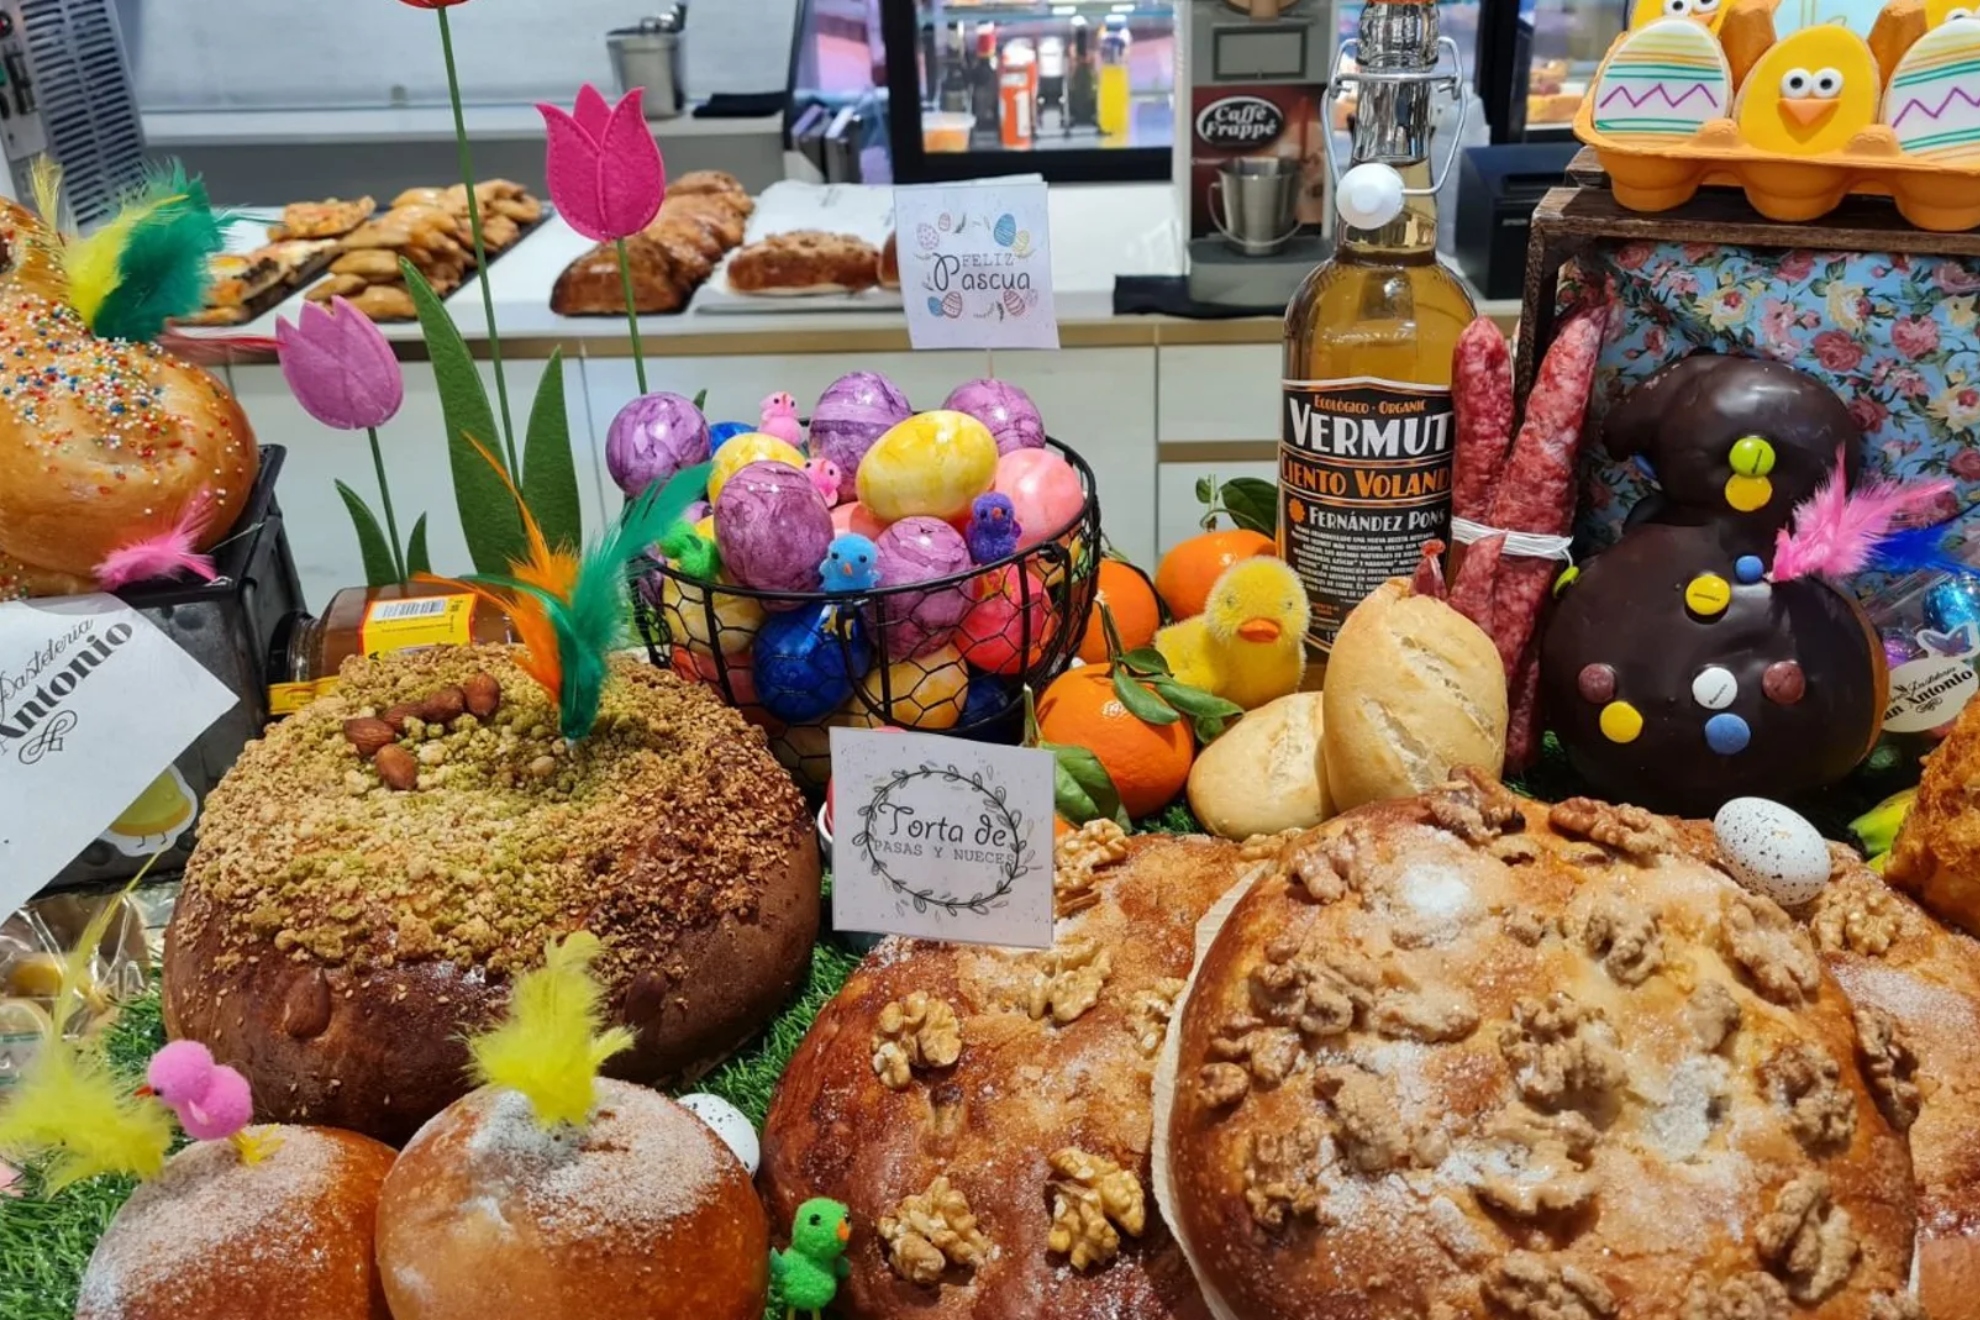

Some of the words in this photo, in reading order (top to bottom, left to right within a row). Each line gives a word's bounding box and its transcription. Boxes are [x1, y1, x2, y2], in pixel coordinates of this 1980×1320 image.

[932, 252, 1031, 292] Pascua
[961, 253, 1015, 268] FELIZ
[1378, 399, 1427, 415] ORGANIC
[1289, 397, 1454, 458] VERMUT
[1309, 505, 1404, 532] FERNÁNDEZ
[1408, 508, 1446, 531] PONS
[1884, 704, 1905, 720] an
[878, 802, 964, 843] Torta
[974, 813, 1007, 848] de
[873, 838, 924, 858] PASAS
[933, 846, 944, 859] Y
[953, 847, 1016, 866] NUECES
